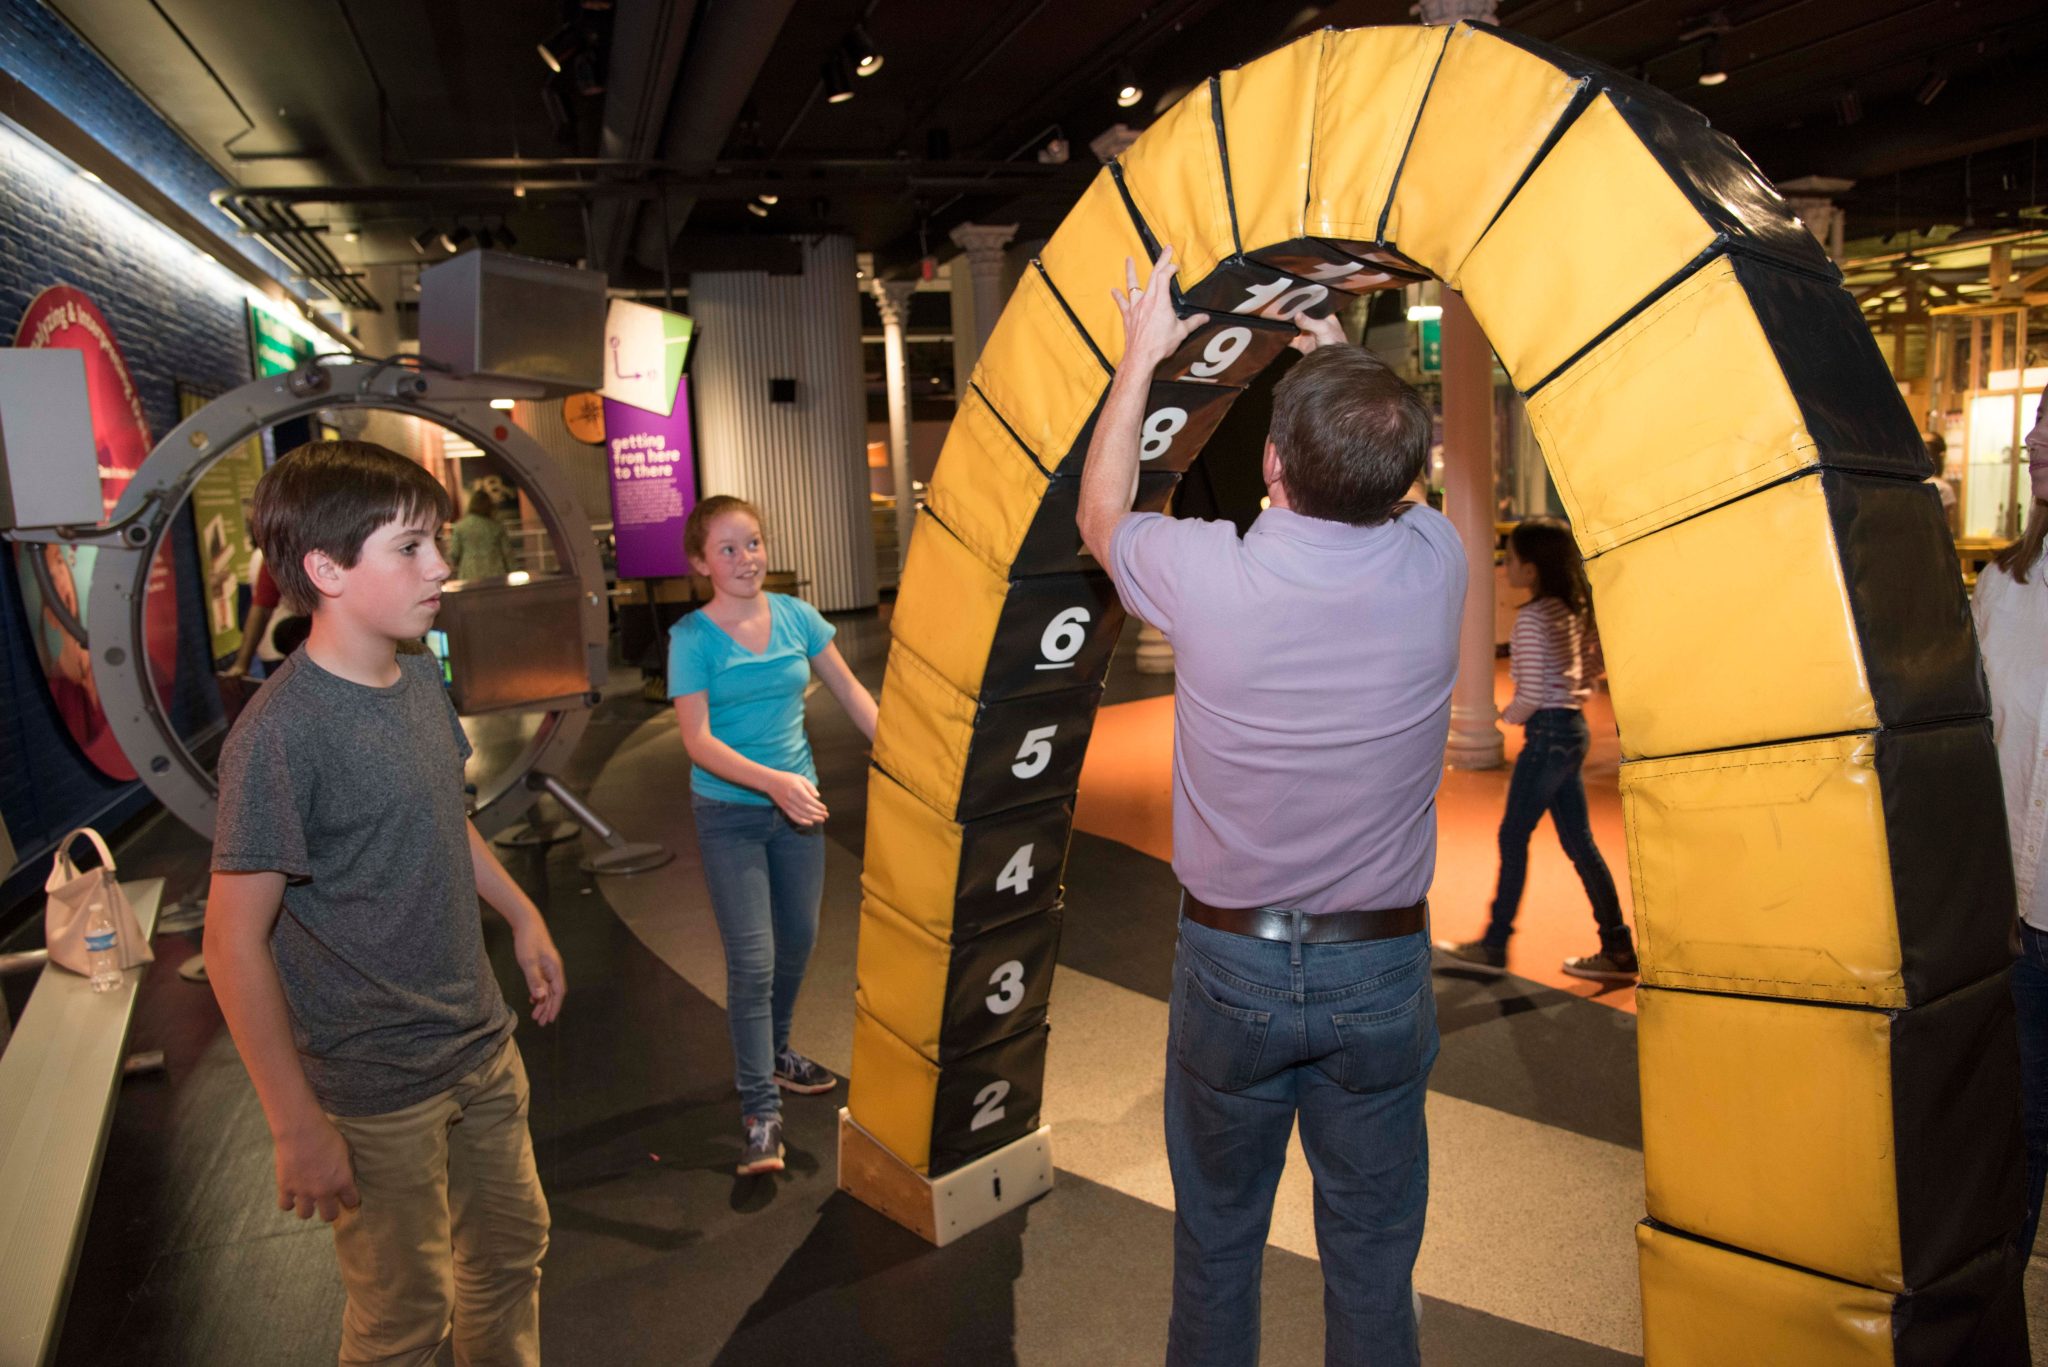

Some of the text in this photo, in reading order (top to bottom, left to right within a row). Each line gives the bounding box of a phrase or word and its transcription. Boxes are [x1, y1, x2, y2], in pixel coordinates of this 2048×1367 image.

[1230, 276, 1329, 321] 10
[1178, 326, 1253, 383] 9
[612, 432, 665, 450] getting
[614, 449, 680, 465] from here
[1139, 406, 1189, 462] 8
[614, 464, 673, 480] to there
[1034, 606, 1092, 672] 6
[1011, 724, 1058, 780] 5
[995, 842, 1035, 896] 4
[985, 959, 1026, 1016] 3
[970, 1080, 1011, 1132] 2
